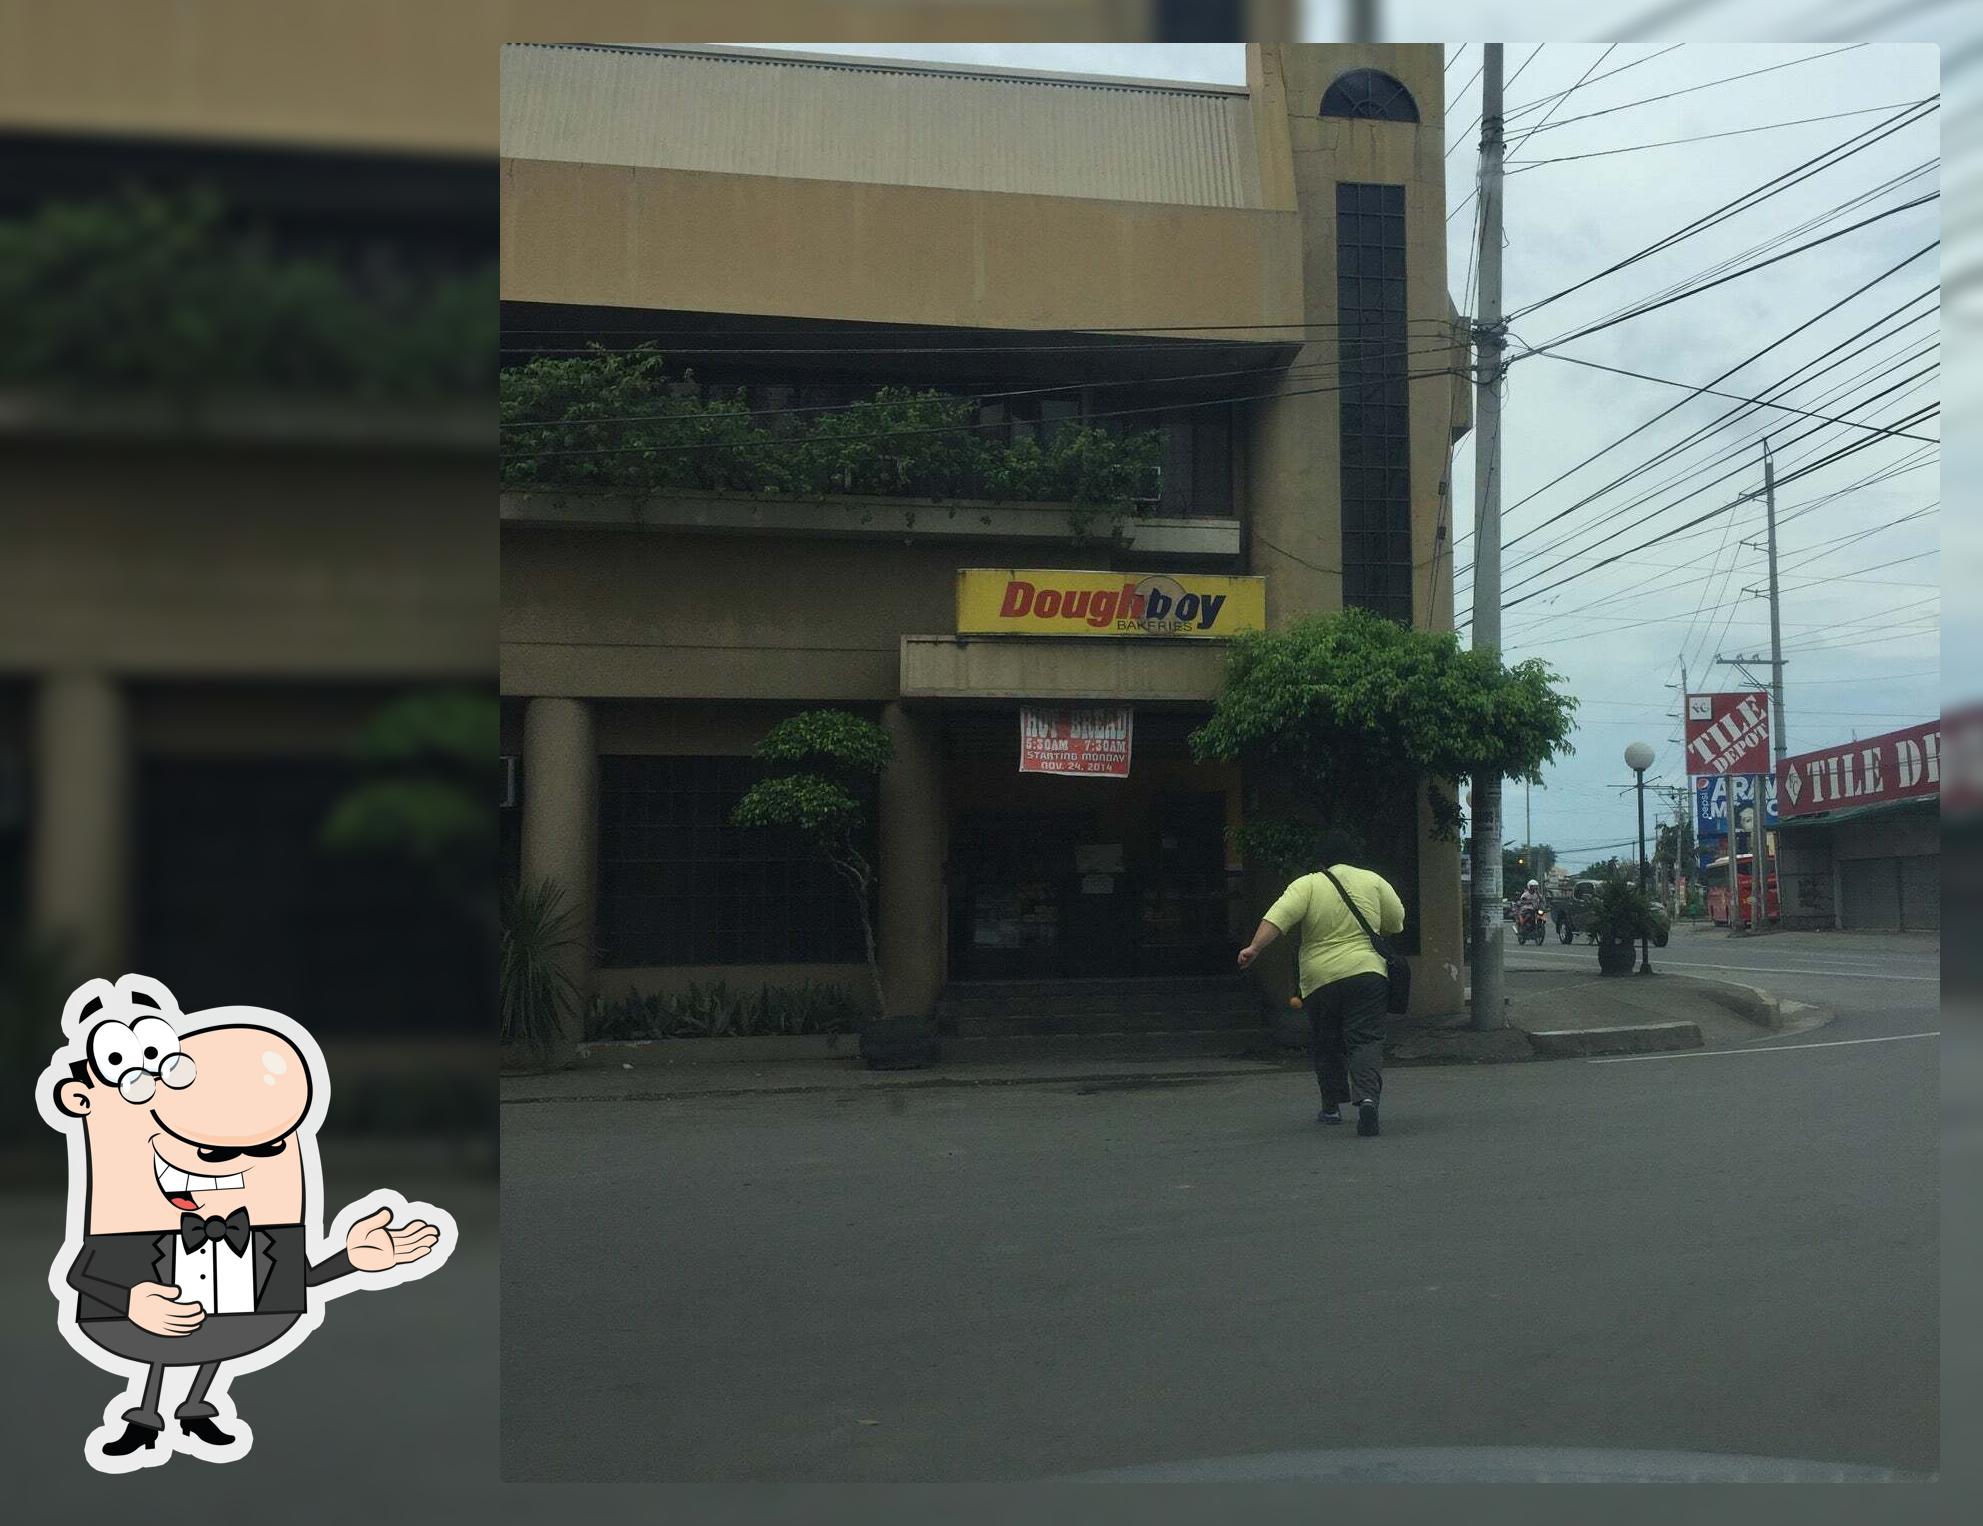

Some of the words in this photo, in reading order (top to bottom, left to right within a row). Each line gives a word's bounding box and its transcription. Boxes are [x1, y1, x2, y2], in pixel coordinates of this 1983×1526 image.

[999, 580, 1227, 629] Doughboy
[1117, 619, 1193, 632] BAKERIES
[1688, 694, 1767, 765] TILE
[1712, 723, 1769, 774] DEPOT
[1087, 763, 1113, 772] 2014
[1806, 746, 1884, 803] TILE
